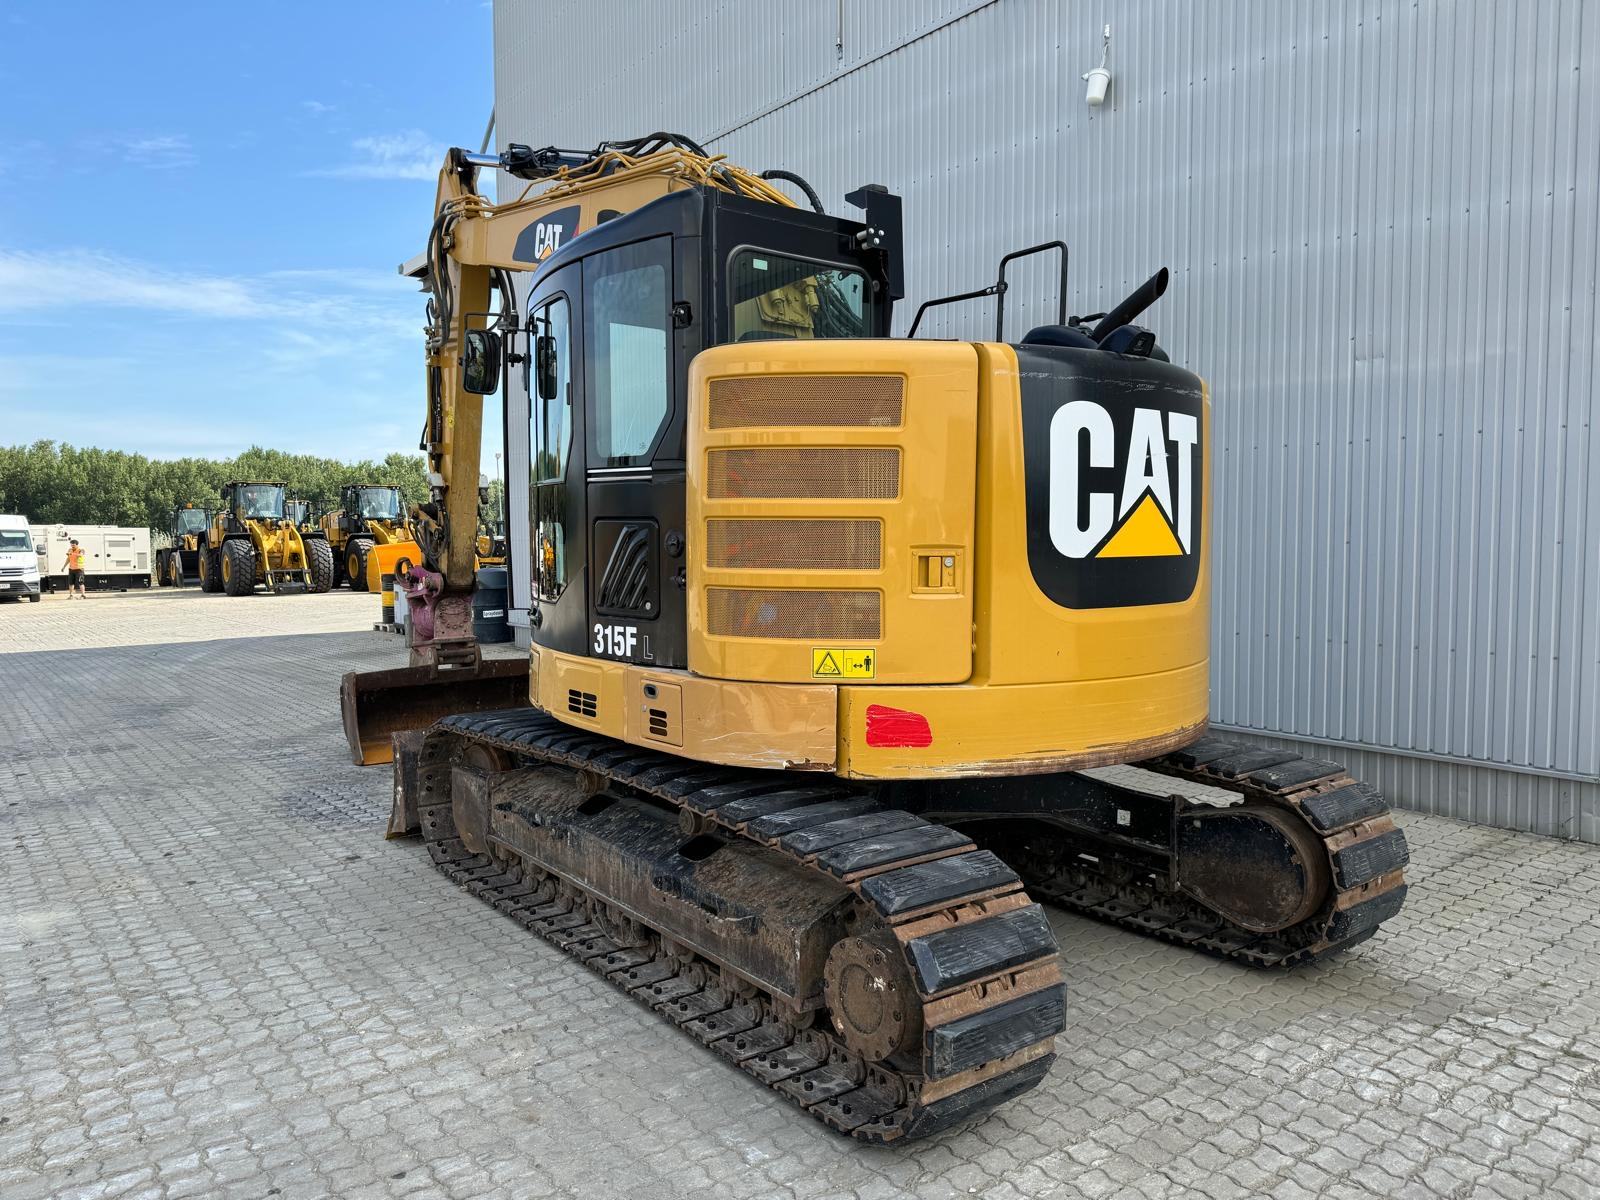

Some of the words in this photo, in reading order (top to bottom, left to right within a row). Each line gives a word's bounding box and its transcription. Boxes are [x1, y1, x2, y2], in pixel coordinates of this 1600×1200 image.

[534, 223, 563, 259] CAT
[1049, 400, 1197, 559] CAT
[593, 623, 638, 657] 315F
[643, 635, 654, 660] L
